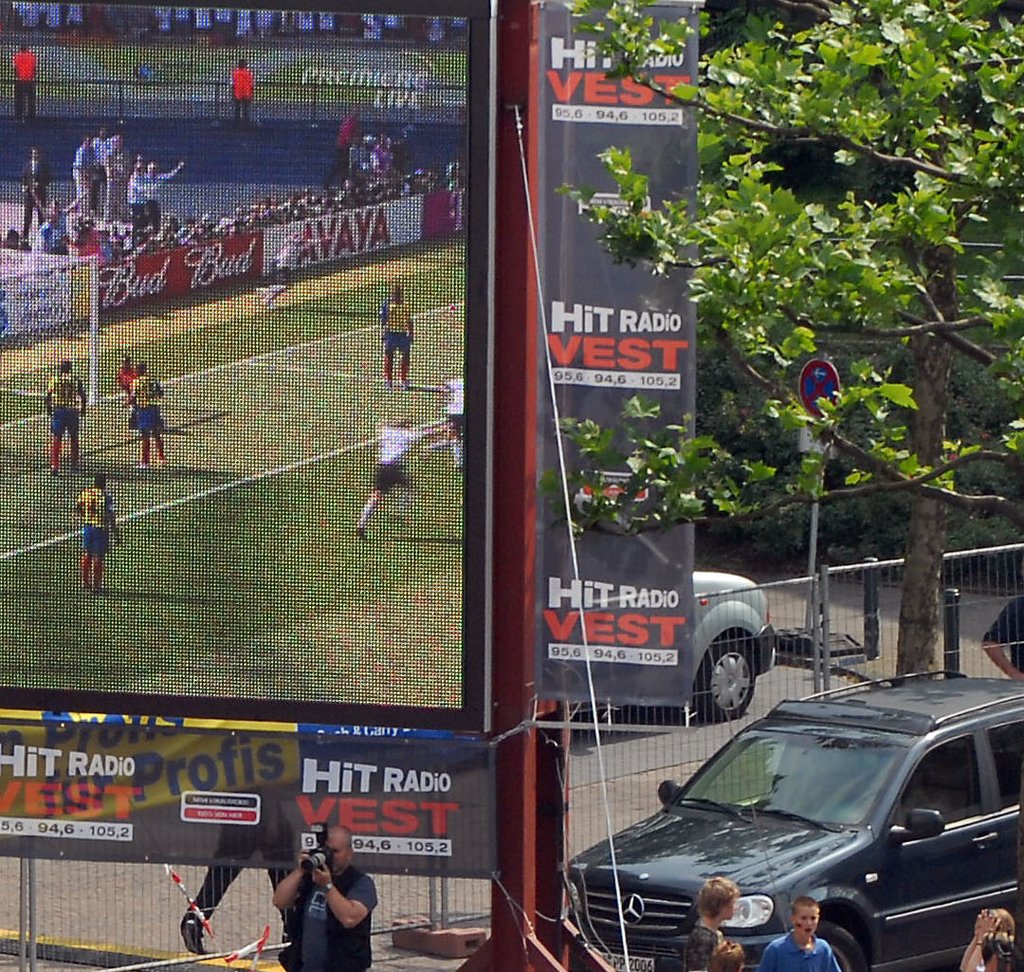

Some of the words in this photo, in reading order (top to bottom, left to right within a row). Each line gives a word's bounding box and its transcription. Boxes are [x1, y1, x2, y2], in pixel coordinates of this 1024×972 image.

[555, 108, 583, 119] 95,6
[596, 110, 628, 121] 94,6
[642, 111, 678, 123] 105,2
[184, 237, 257, 289] Bud
[99, 256, 170, 307] Bud
[547, 335, 689, 371] VEST
[554, 371, 583, 383] 95,6
[594, 373, 626, 385] 94,6
[639, 375, 677, 387] 105,2
[542, 609, 686, 647] VEST
[551, 646, 581, 658] 95,6
[594, 648, 626, 660] 94,6
[637, 650, 675, 664] 105,2
[296, 795, 460, 835] VEST
[37, 823, 74, 836] 94,6
[90, 825, 129, 838] 105,2
[353, 839, 391, 851] 94,6
[407, 841, 448, 853] 105,2
[629, 958, 653, 972] 2006
